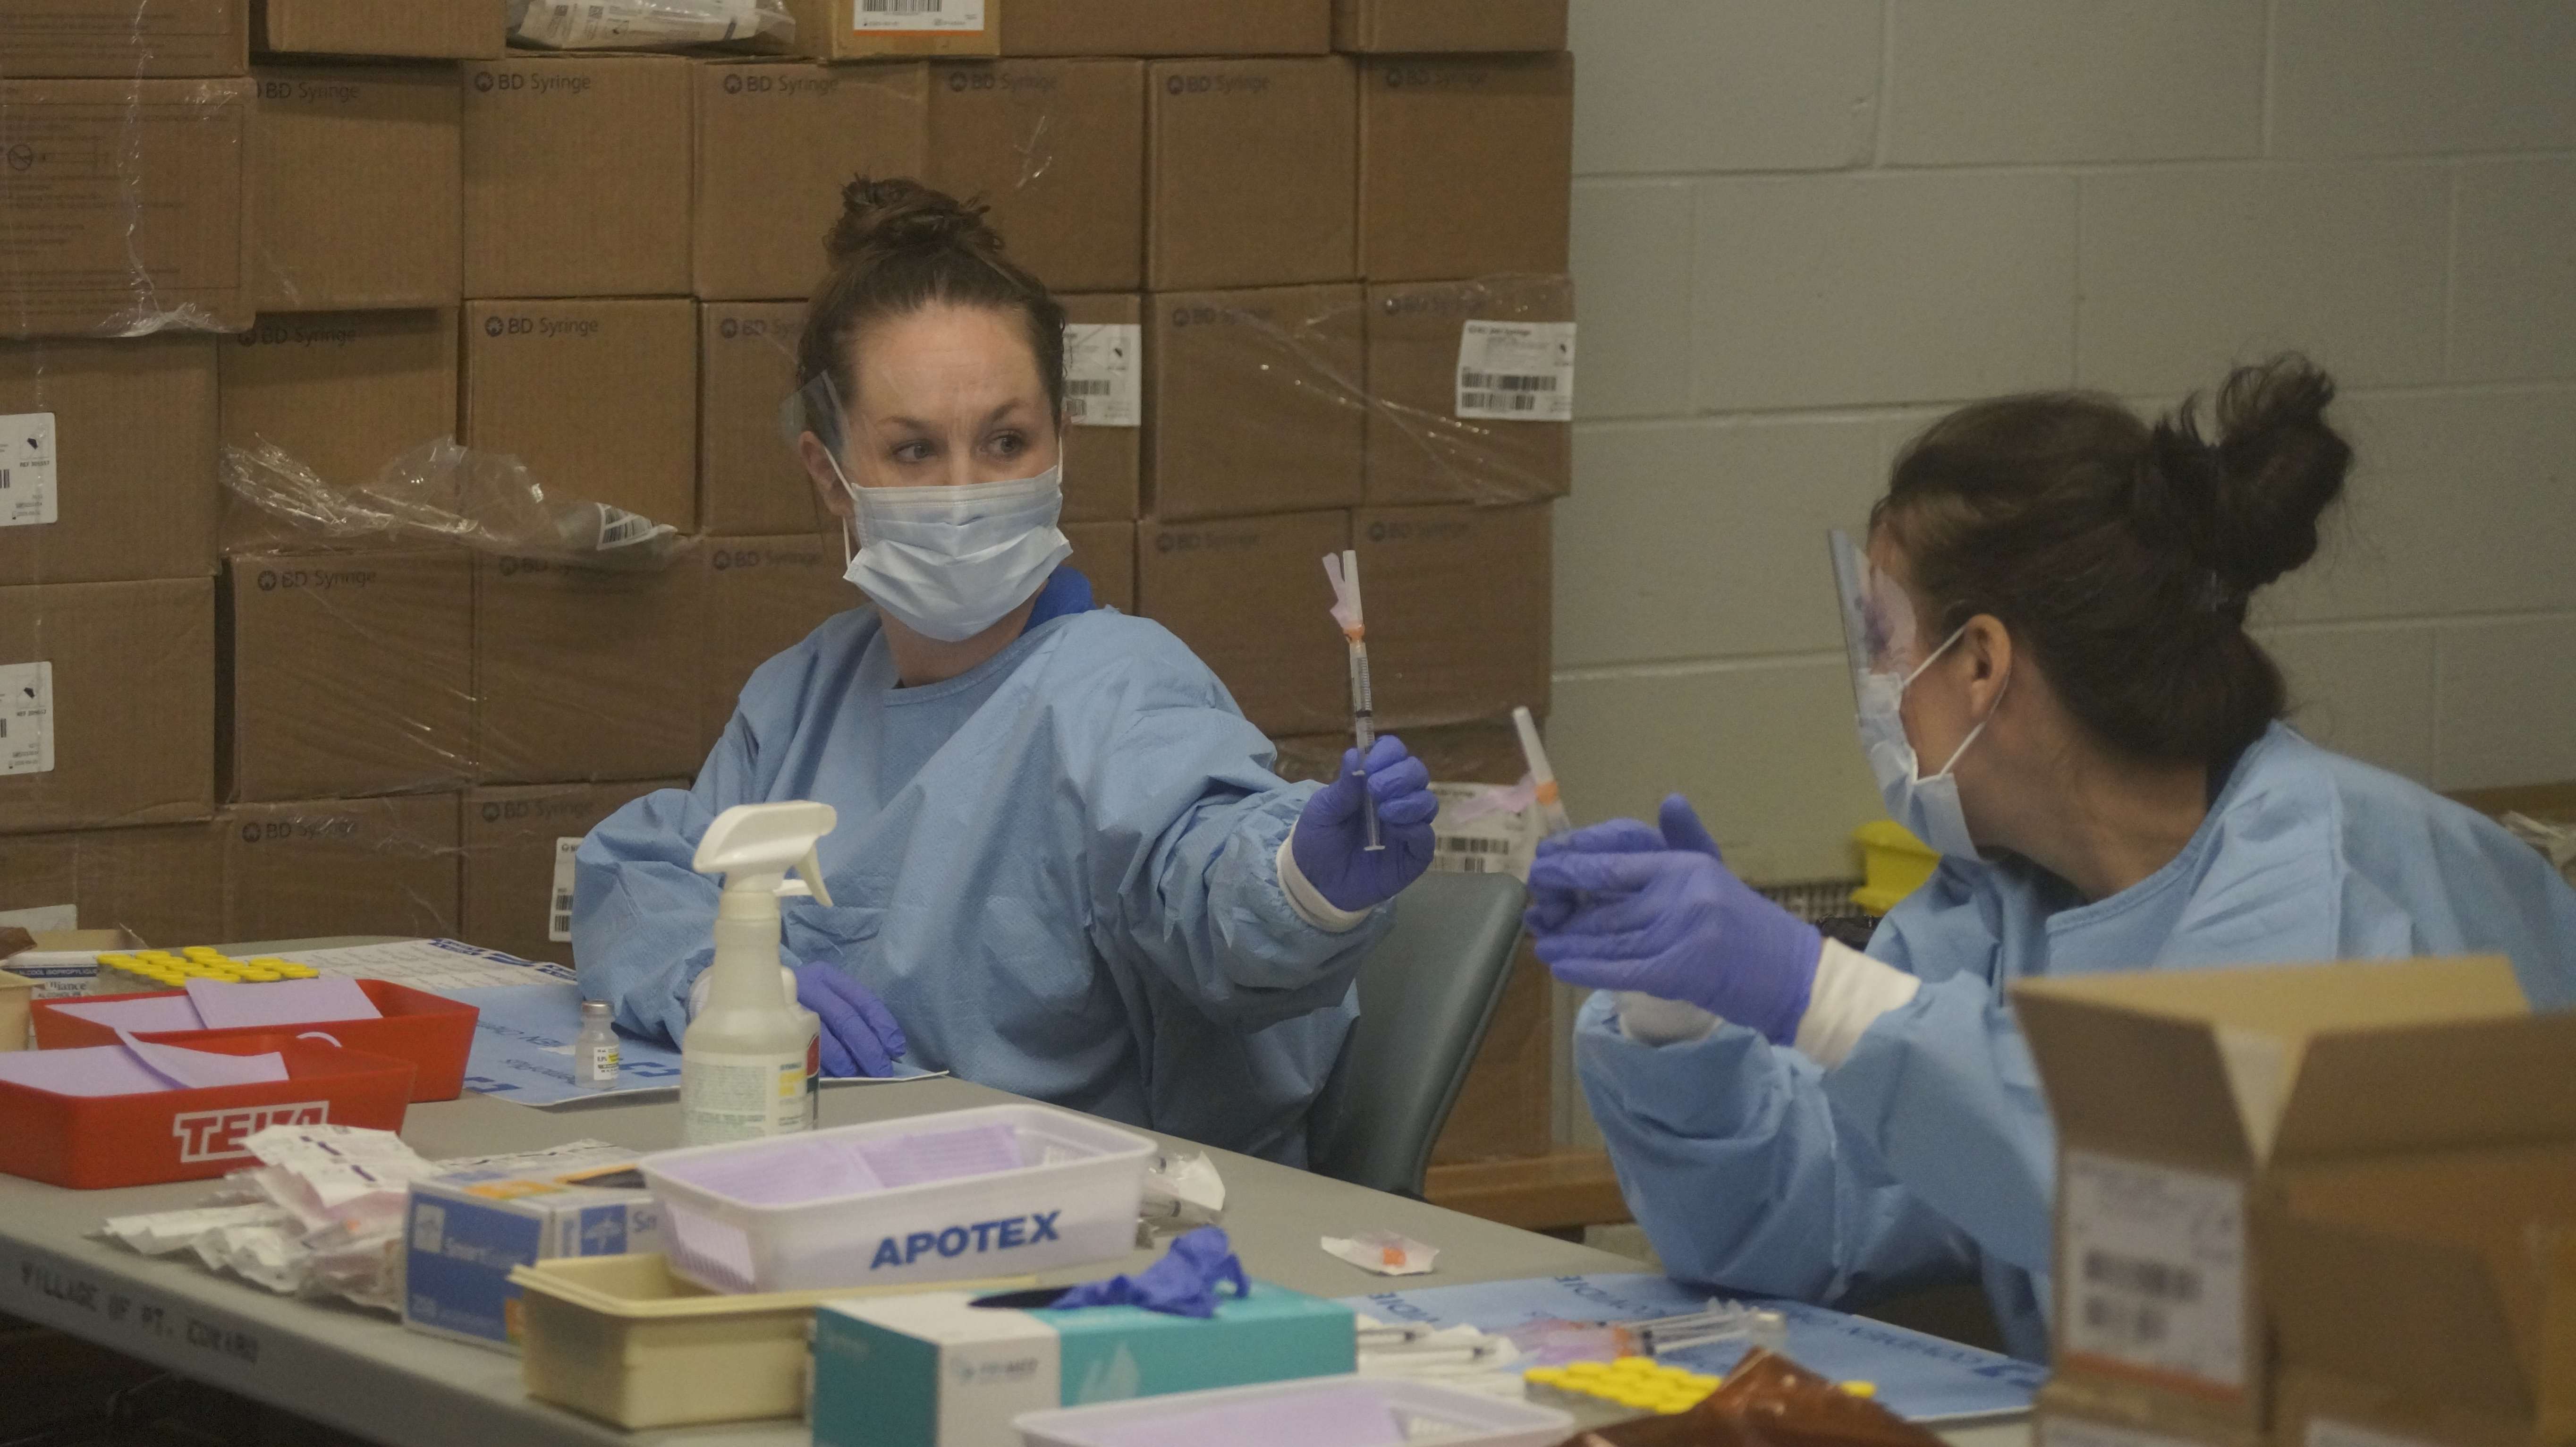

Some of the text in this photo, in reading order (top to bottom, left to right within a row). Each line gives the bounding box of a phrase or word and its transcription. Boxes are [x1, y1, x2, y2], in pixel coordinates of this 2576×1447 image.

[499, 73, 590, 94] BD Syringe
[747, 75, 840, 96] BD Syringe
[972, 74, 995, 89] BD
[1187, 76, 1211, 92] BD
[266, 83, 359, 102] BD Syringe
[508, 317, 598, 337] BD Syringe
[742, 319, 767, 336] BD
[262, 329, 357, 347] BD Syringe
[735, 550, 760, 567] BD
[282, 570, 377, 589] BD Syringe
[505, 800, 595, 819] BD Syringe
[266, 823, 291, 838] BD
[870, 1209, 1062, 1269] APOTEX
